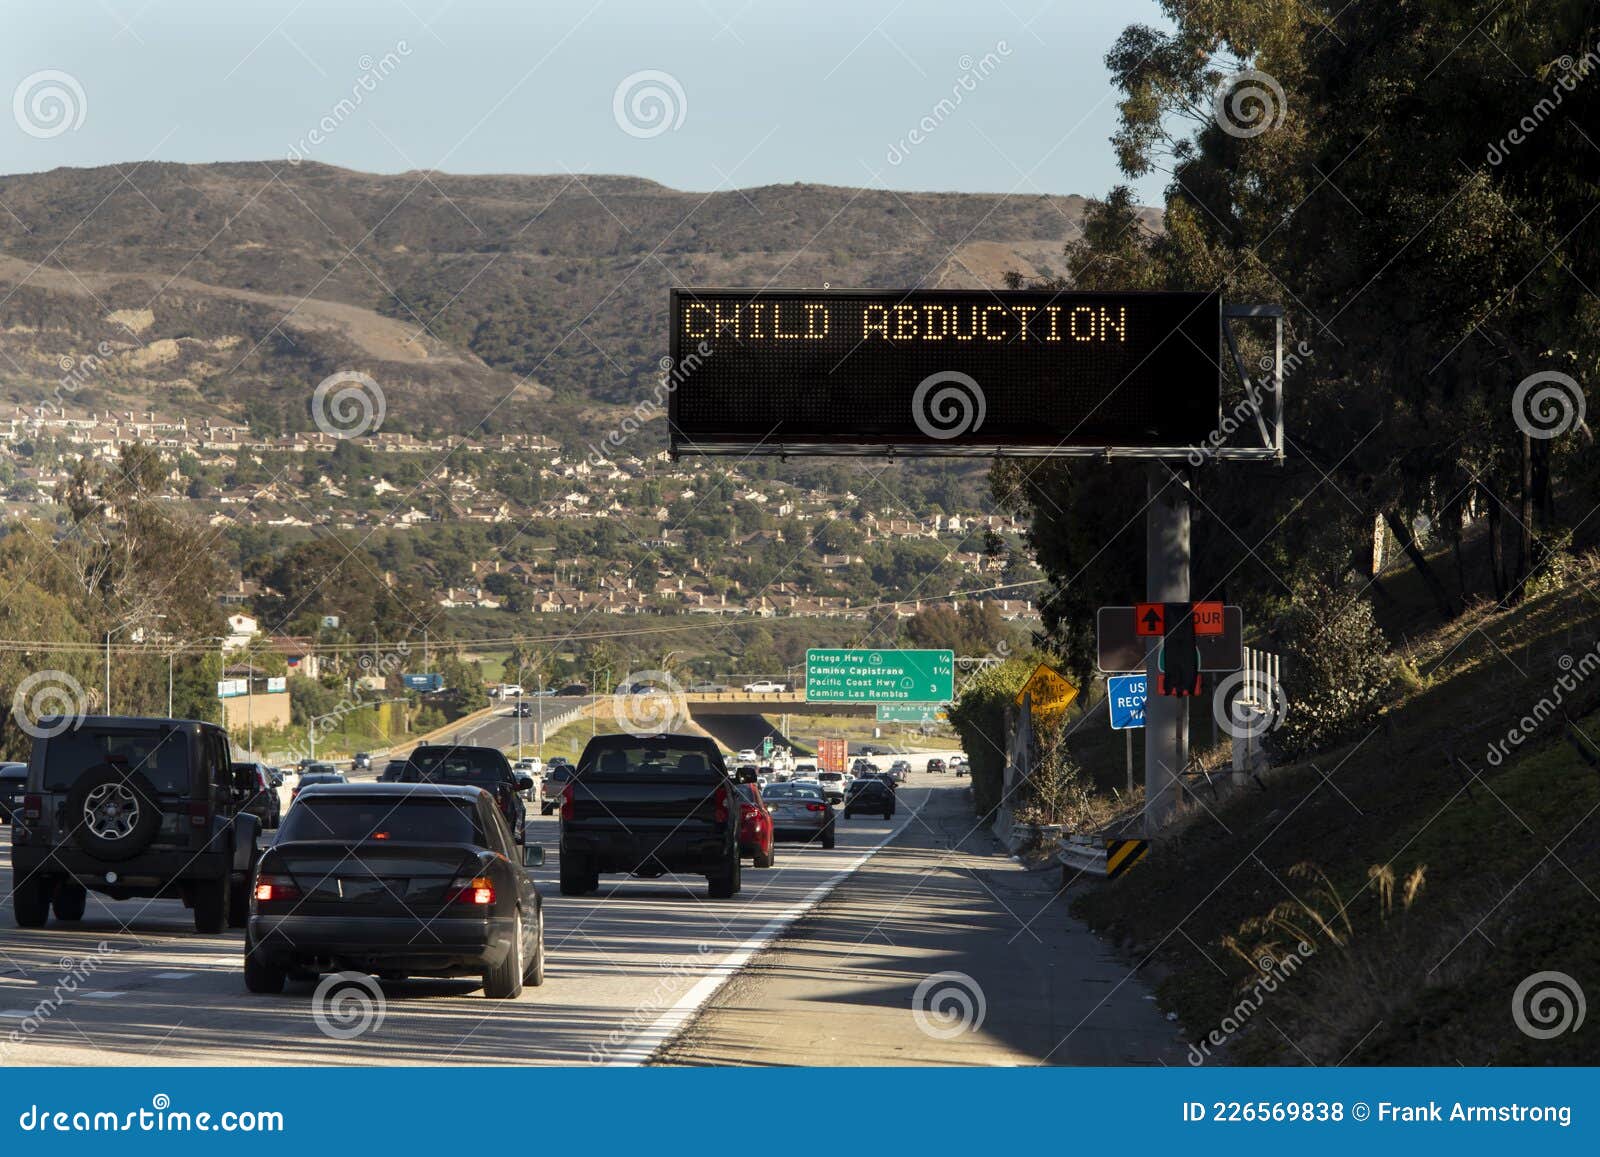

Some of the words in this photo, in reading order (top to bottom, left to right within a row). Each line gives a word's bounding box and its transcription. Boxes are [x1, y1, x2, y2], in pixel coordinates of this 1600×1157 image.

[685, 303, 829, 339] CHILD
[863, 305, 1127, 342] ABDUCTION
[810, 654, 841, 664] Ortega
[844, 654, 865, 664] Hwy
[810, 666, 846, 675] Camino
[849, 666, 904, 677] Capistrano
[809, 678, 842, 686] Pacific
[846, 678, 872, 686] Coast
[876, 679, 897, 688] Hwy
[930, 684, 937, 693] 3
[1129, 683, 1148, 694] US
[810, 689, 845, 697] Camino
[848, 690, 866, 698] Las
